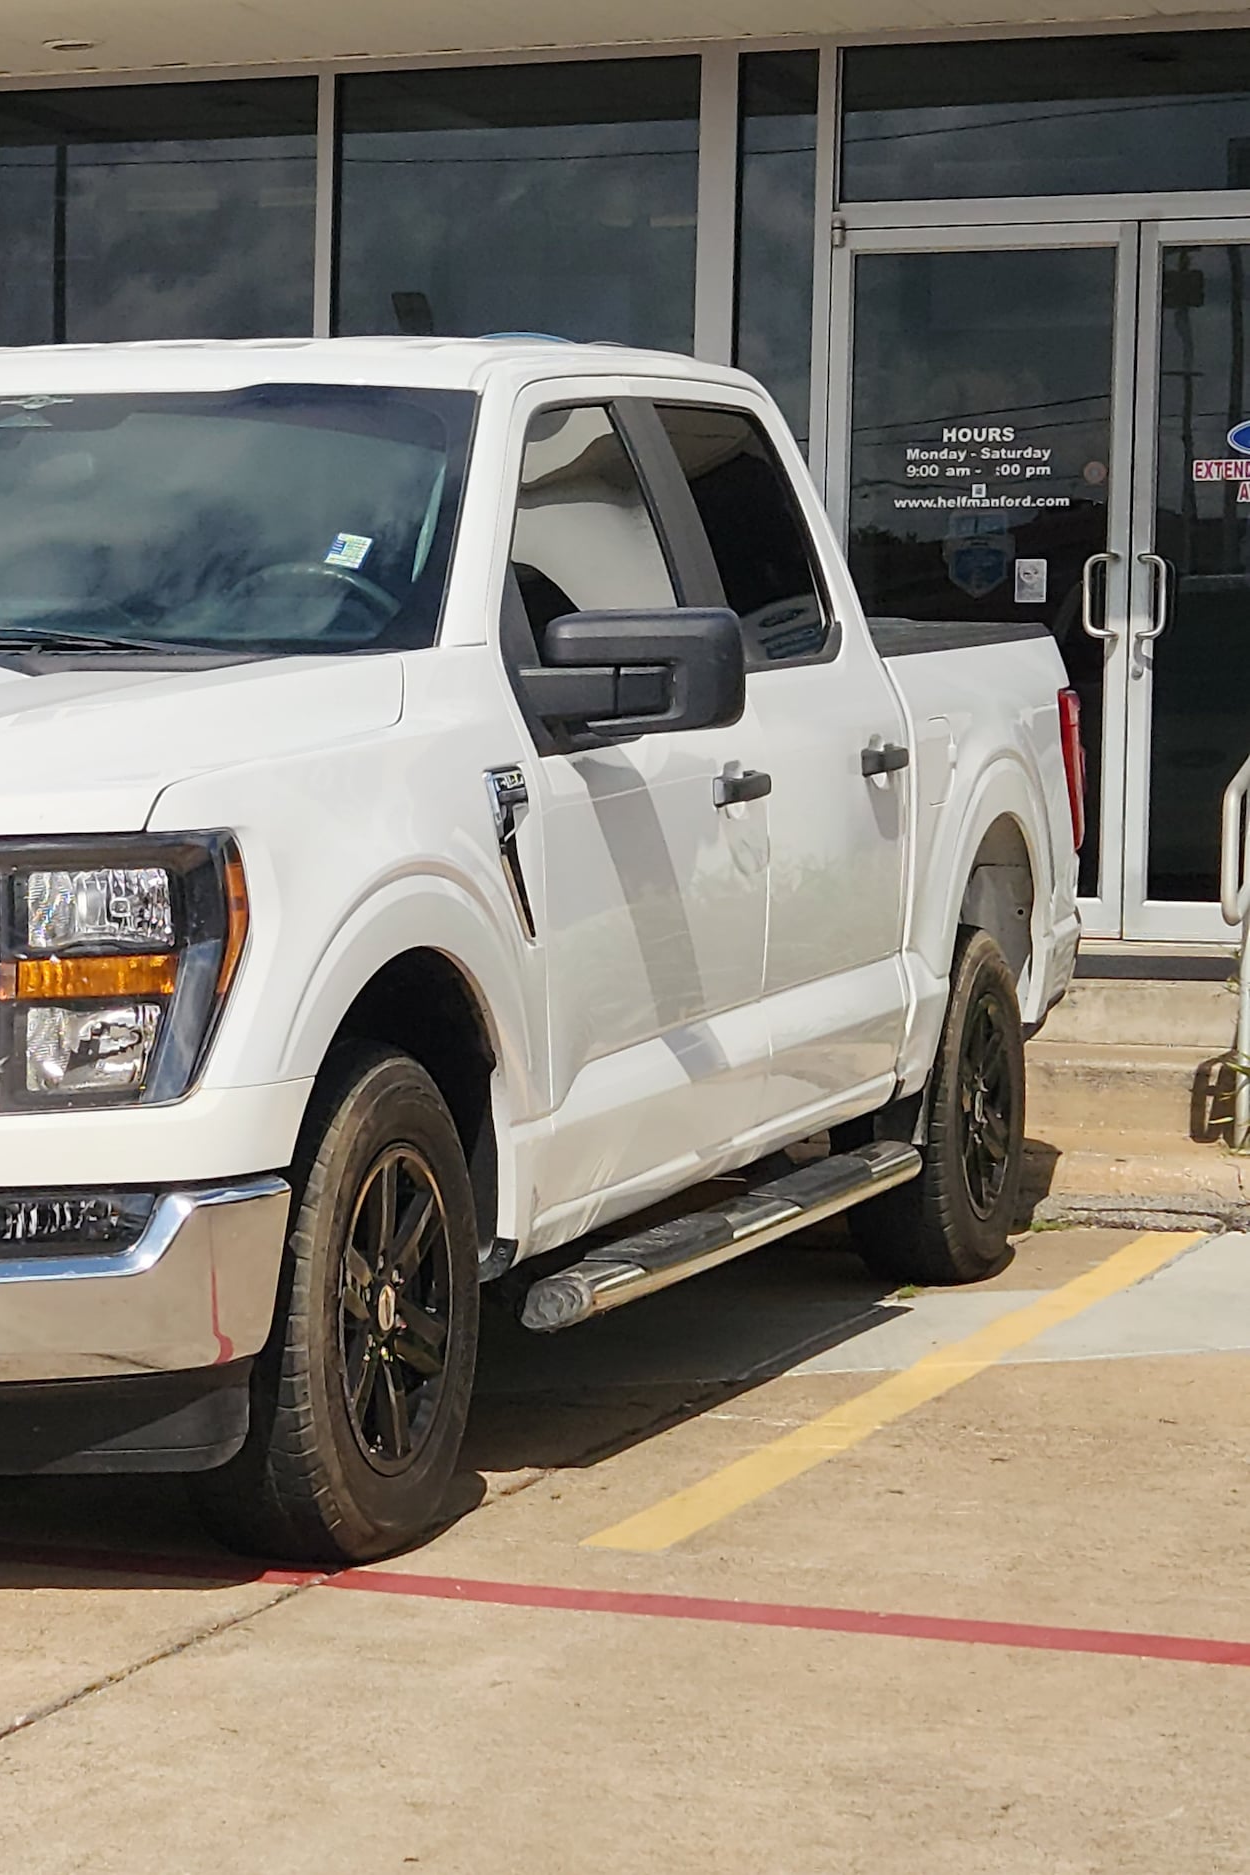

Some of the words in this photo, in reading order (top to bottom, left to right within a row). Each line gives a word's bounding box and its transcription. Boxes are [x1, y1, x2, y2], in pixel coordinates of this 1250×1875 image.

[943, 427, 1015, 443] HOURS
[906, 447, 967, 463] Monday
[980, 446, 1052, 462] Saturday
[906, 464, 939, 477] 9:00
[945, 467, 971, 477] am
[1025, 466, 1052, 478] pm
[893, 495, 1071, 508] www.helfmanford.com
